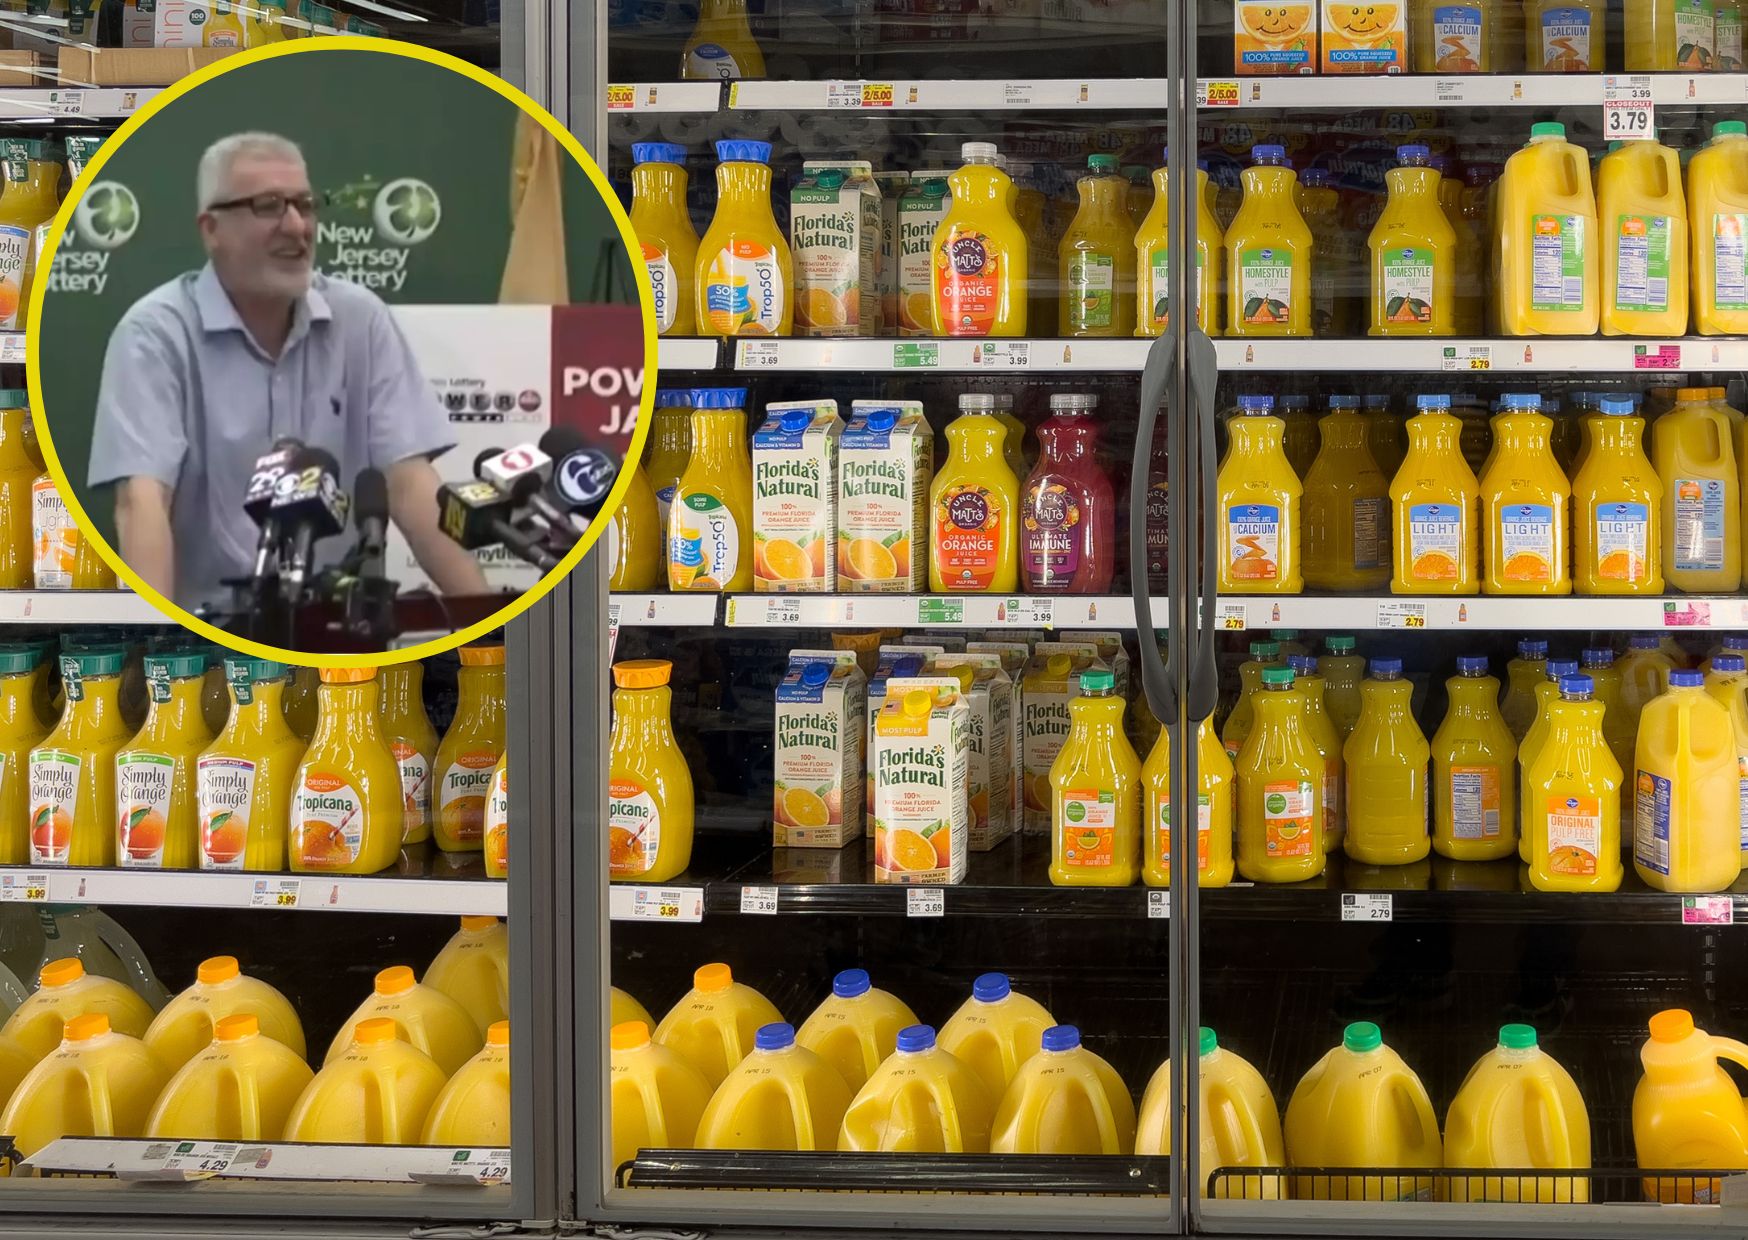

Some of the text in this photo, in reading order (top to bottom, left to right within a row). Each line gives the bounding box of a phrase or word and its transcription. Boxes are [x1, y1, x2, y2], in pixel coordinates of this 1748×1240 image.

[191, 12, 205, 20] 100
[1677, 14, 1712, 28] HOMESTYLE
[1443, 25, 1479, 36] CALCIUM
[1550, 27, 1587, 37] CALCIUM
[1717, 26, 1740, 36] STYLE
[1244, 53, 1270, 62] 100%
[1332, 52, 1358, 61] 100%
[864, 90, 893, 101] 2/5.00
[1209, 89, 1238, 100] 2/5.00
[1632, 90, 1651, 98] 3.99
[844, 98, 861, 106] 3.39
[65, 105, 81, 114] 4.49
[1610, 112, 1648, 130] 3.79
[801, 194, 831, 203] NO PULP
[317, 221, 373, 244] New
[793, 231, 855, 252] Natural
[952, 239, 983, 255] UNCLE
[53, 252, 110, 272] ersey
[329, 243, 410, 271] Jersey
[1244, 268, 1289, 278] HOMESTYLE
[1386, 267, 1431, 278] HOMESTYLE
[1264, 279, 1278, 287] PULP
[1405, 278, 1419, 287] PULP
[942, 286, 994, 298] ORANGE
[761, 356, 778, 365] 3.69
[920, 355, 938, 366] 5.49
[1009, 356, 1028, 365] 3.99
[1470, 360, 1489, 370] 2.79
[756, 478, 819, 500] Natural
[842, 478, 905, 500] Natural
[954, 494, 984, 508] UNCLE
[952, 508, 984, 522] MATT'S
[1237, 523, 1276, 535] CALCIUM
[1413, 524, 1457, 534] LIGHT
[1505, 524, 1549, 535] LIGHT
[1600, 523, 1644, 533] LIGHT
[942, 540, 994, 551] ORANGE
[1030, 539, 1072, 550] IMMUNE
[782, 612, 800, 622] 3.69
[944, 612, 963, 622] 5.49
[1033, 612, 1052, 622] 3.99
[1405, 617, 1424, 627] 2.79
[1225, 618, 1244, 629] 2.79
[778, 731, 838, 752] Natural
[460, 755, 497, 764] ORIGINAL
[880, 746, 945, 769] Florida's
[32, 763, 74, 789] Simply
[120, 765, 167, 791] Simply
[880, 766, 945, 788] Natural
[202, 769, 249, 795] Simply
[306, 778, 341, 786] ORIGINAL
[31, 784, 73, 804] Orange
[610, 785, 639, 793] RIGINAL
[120, 785, 167, 805] Orange
[201, 789, 248, 811] Orange
[904, 791, 921, 799] 100%
[296, 792, 353, 811] Tropicana
[610, 799, 649, 818] picana
[1551, 816, 1594, 828] ORIGINAL
[1550, 828, 1594, 840] PULP FREE
[28, 889, 47, 899] 3.99
[278, 895, 297, 906] 3.99
[759, 901, 776, 911] 3.69
[660, 905, 680, 916] 3.99
[925, 903, 943, 912] 3.69
[1371, 909, 1390, 919] 2.79
[1358, 1065, 1383, 1079] APR 07
[200, 1160, 229, 1171] 4.29
[480, 1166, 508, 1178] 4.29
